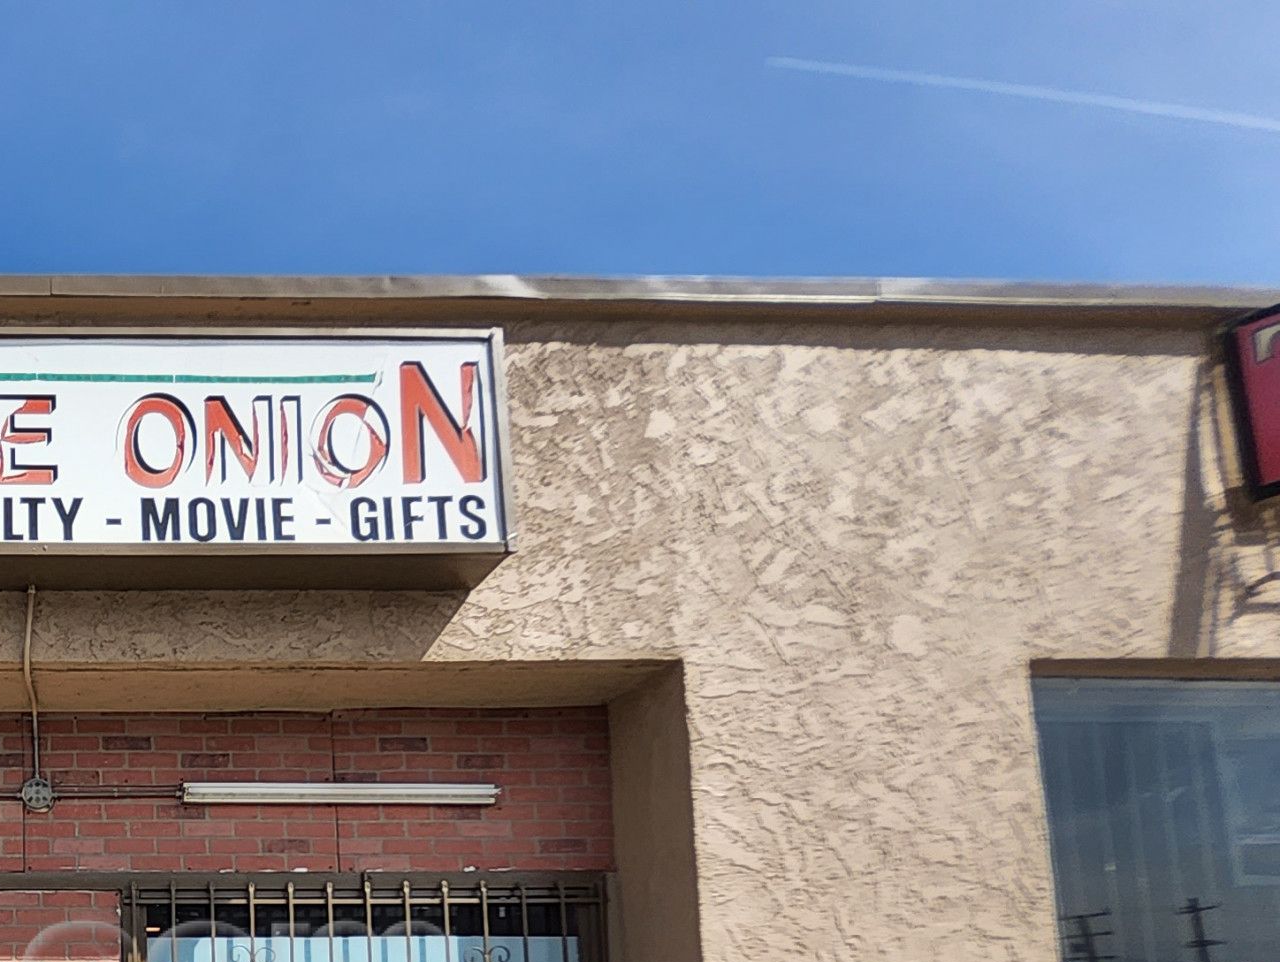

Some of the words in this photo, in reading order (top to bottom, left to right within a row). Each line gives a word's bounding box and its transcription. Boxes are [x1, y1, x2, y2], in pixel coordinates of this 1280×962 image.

[117, 360, 487, 489] ONION
[140, 497, 296, 542] MOVIE
[350, 496, 487, 541] GIFTS
